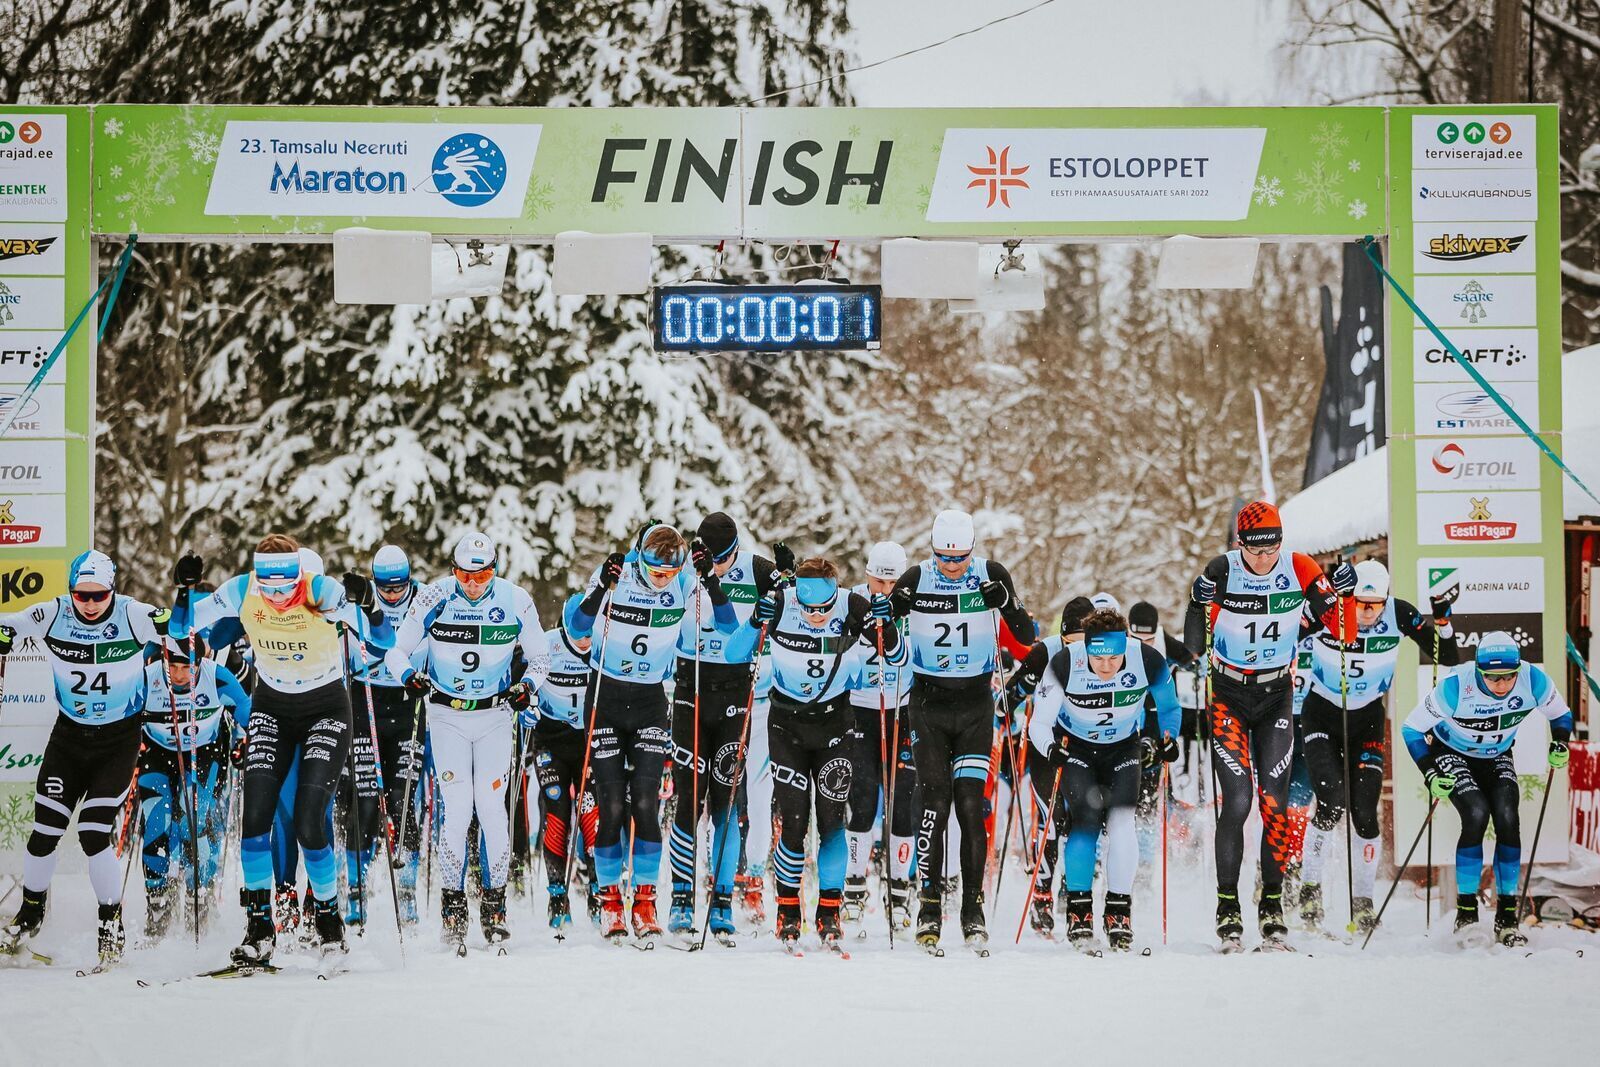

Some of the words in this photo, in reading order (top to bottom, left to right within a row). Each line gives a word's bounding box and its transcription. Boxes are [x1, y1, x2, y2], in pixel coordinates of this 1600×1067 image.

[239, 139, 267, 155] 23.
[270, 139, 338, 155] Tamsalu
[344, 140, 408, 155] Neeruti
[1425, 148, 1523, 162] terviserajad.ee
[591, 138, 895, 206] FINISH
[1049, 157, 1209, 178] ESTOLOPPET
[268, 160, 408, 195] Maraton
[1050, 189, 1072, 197] EESTI
[1074, 189, 1168, 197] PIKAMAASUUSATAJATE
[1170, 189, 1189, 197] SARI
[1190, 189, 1209, 197] 2022
[1428, 189, 1532, 198] KULUKAUBANDUS
[1430, 234, 1512, 254] skiwax
[1452, 293, 1494, 303] SAARE
[1425, 349, 1504, 363] CRAFT
[1436, 418, 1515, 429] ESTMARE
[1453, 462, 1516, 480] JETOIL
[3, 528, 36, 544] Pagar
[1450, 525, 1478, 538] Eesti
[1479, 526, 1513, 541] Pagar
[726, 587, 756, 600] Nelson
[934, 582, 962, 591] Maraton
[1242, 582, 1271, 591] Maraton
[1465, 583, 1504, 592] KADRINA
[1507, 582, 1530, 591] VALD
[915, 599, 945, 609] CRAFT
[964, 596, 985, 609] Nels
[1223, 599, 1254, 610] CRAFT
[452, 612, 484, 622] Maraton
[69, 630, 101, 641] Maraton
[432, 628, 465, 640] CRAFT
[933, 621, 969, 648] 21
[1243, 620, 1282, 644] 14
[258, 638, 309, 652] LIIDER
[630, 633, 649, 656] 6
[776, 635, 809, 648] CRAFT
[460, 650, 481, 674] 9
[806, 659, 825, 679] 8
[1348, 659, 1365, 679] 5
[70, 670, 112, 696] 24
[22, 694, 46, 703] VALD
[1095, 711, 1115, 727] 2
[916, 808, 938, 882] ESTONIA
